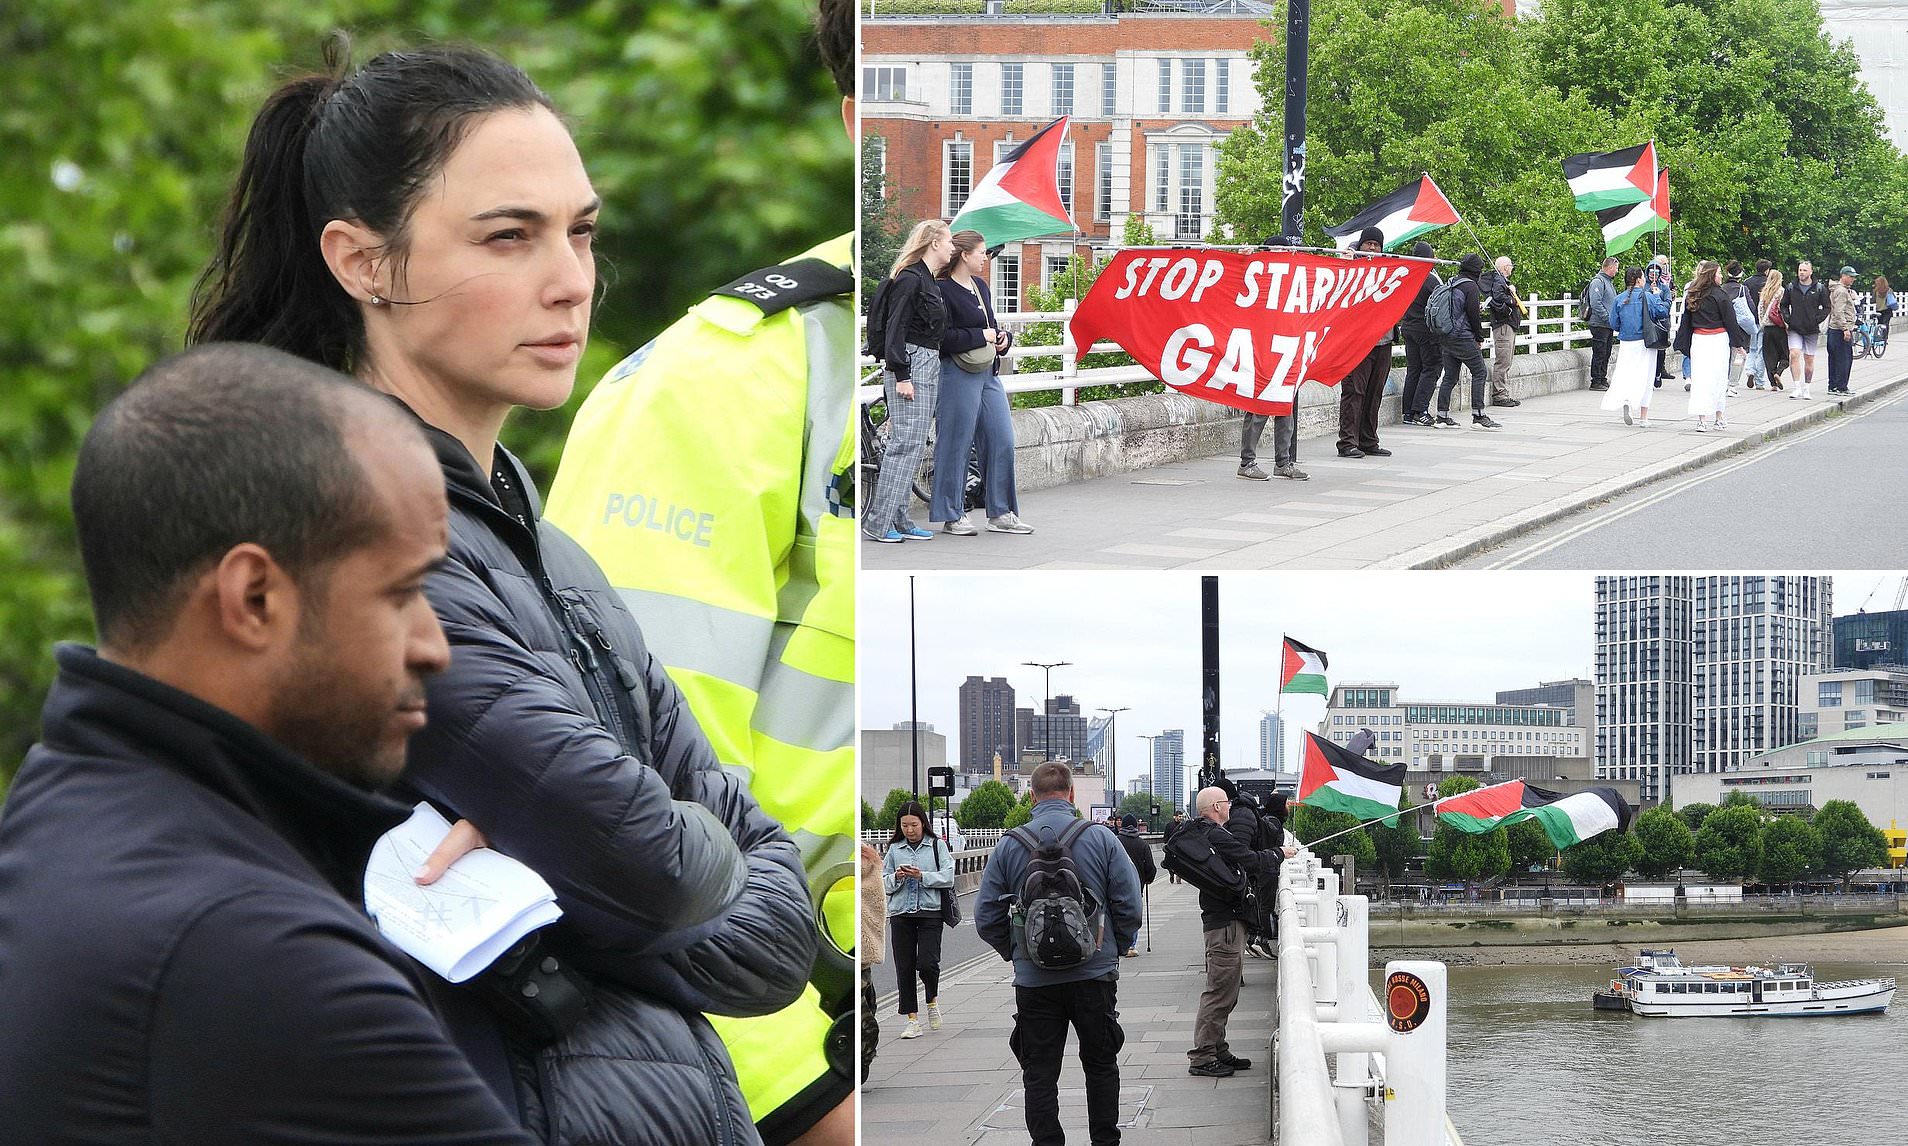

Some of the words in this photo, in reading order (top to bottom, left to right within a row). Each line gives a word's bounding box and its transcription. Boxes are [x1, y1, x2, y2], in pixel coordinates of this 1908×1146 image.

[733, 282, 778, 300] 273
[764, 273, 799, 289] OD
[1114, 257, 1225, 303] STOP
[1236, 262, 1409, 314] STARVING
[602, 492, 715, 548] POLICE
[1410, 979, 1427, 1002] MILANO
